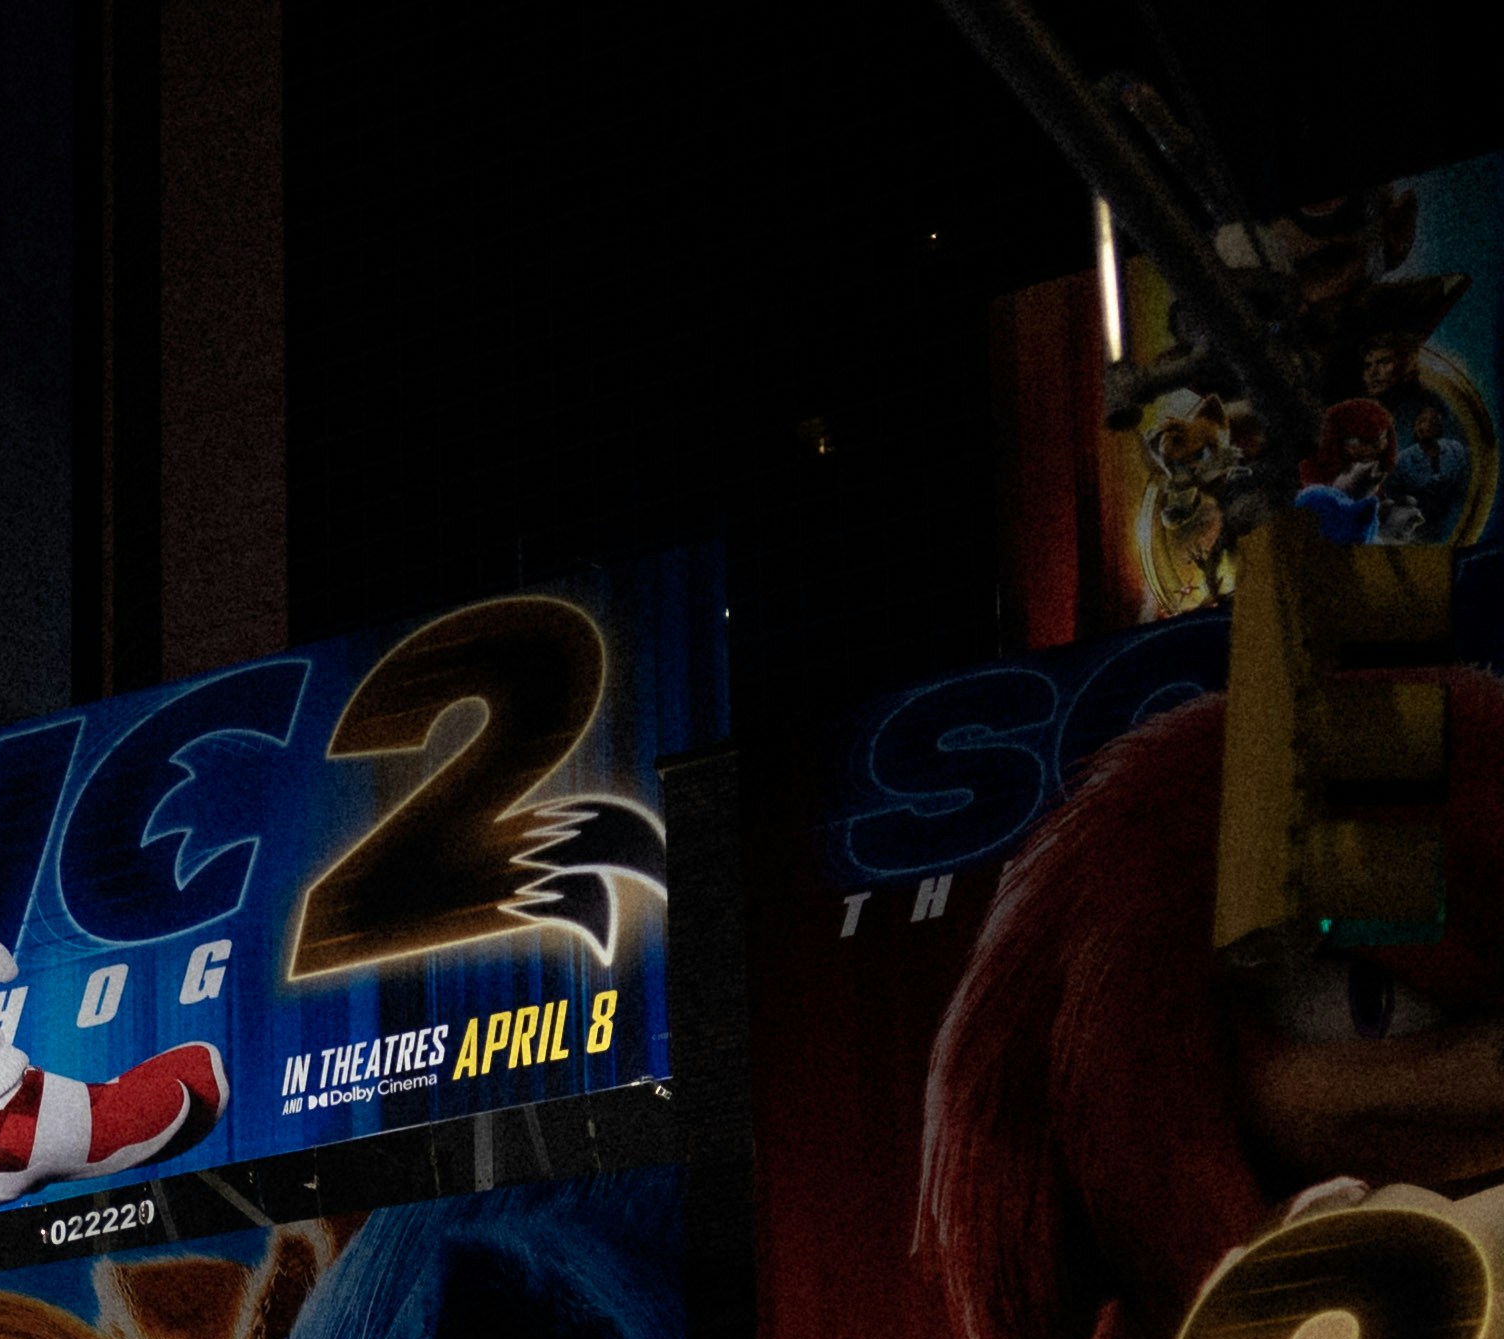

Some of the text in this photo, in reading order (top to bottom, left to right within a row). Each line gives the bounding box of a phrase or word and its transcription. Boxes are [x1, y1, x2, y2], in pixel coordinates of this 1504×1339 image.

[283, 594, 667, 980] 2
[282, 990, 618, 1096] IN THEATRES APRIL 8
[282, 1072, 437, 1116] AND Dolby Cinema
[50, 1200, 155, 1245] 022220
